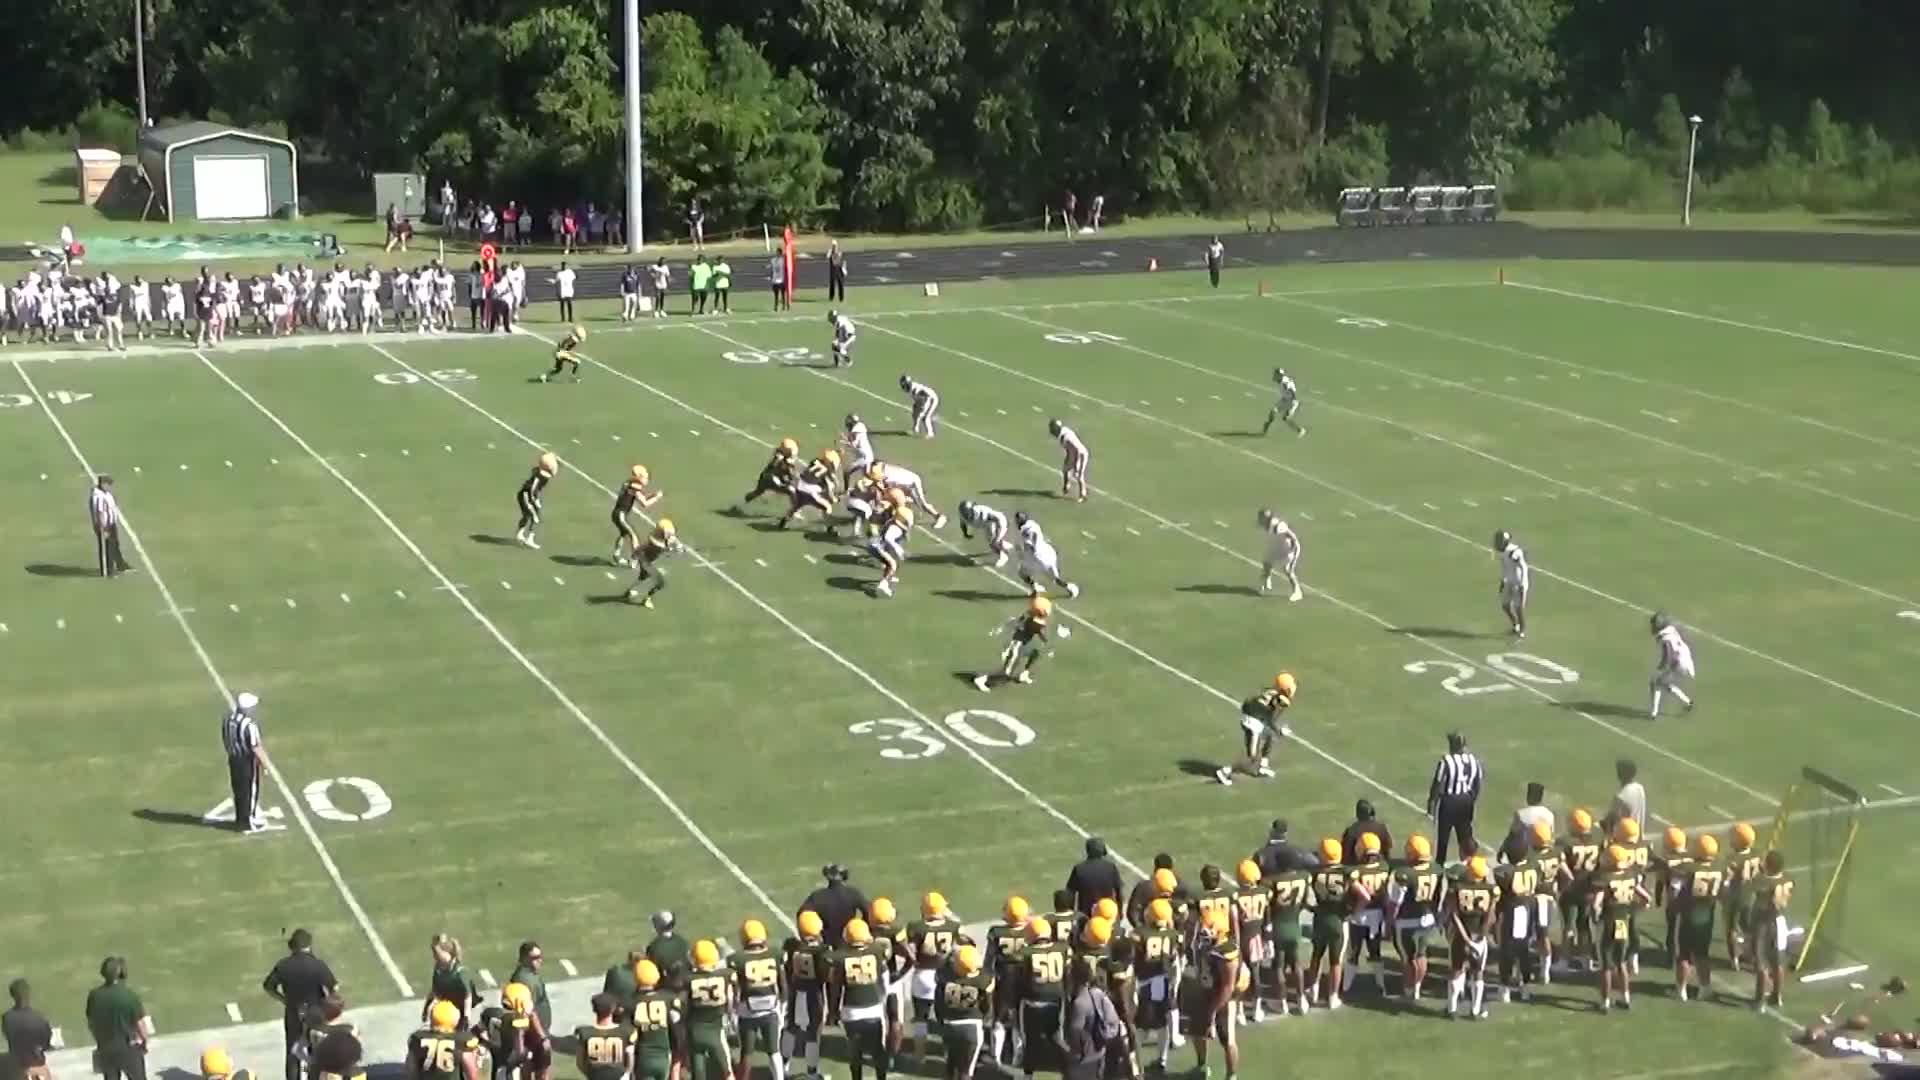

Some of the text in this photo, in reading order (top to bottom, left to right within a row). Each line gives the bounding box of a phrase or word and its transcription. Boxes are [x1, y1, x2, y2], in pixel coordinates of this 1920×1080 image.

[1403, 652, 1579, 696] 20
[849, 709, 1036, 759] 30
[1276, 880, 1306, 905] 27
[745, 957, 778, 987] 95
[1031, 952, 1064, 984] 50
[691, 976, 726, 1007] 53
[634, 1000, 669, 1031] 49
[420, 1038, 456, 1073] 76
[587, 1036, 624, 1064] 90
